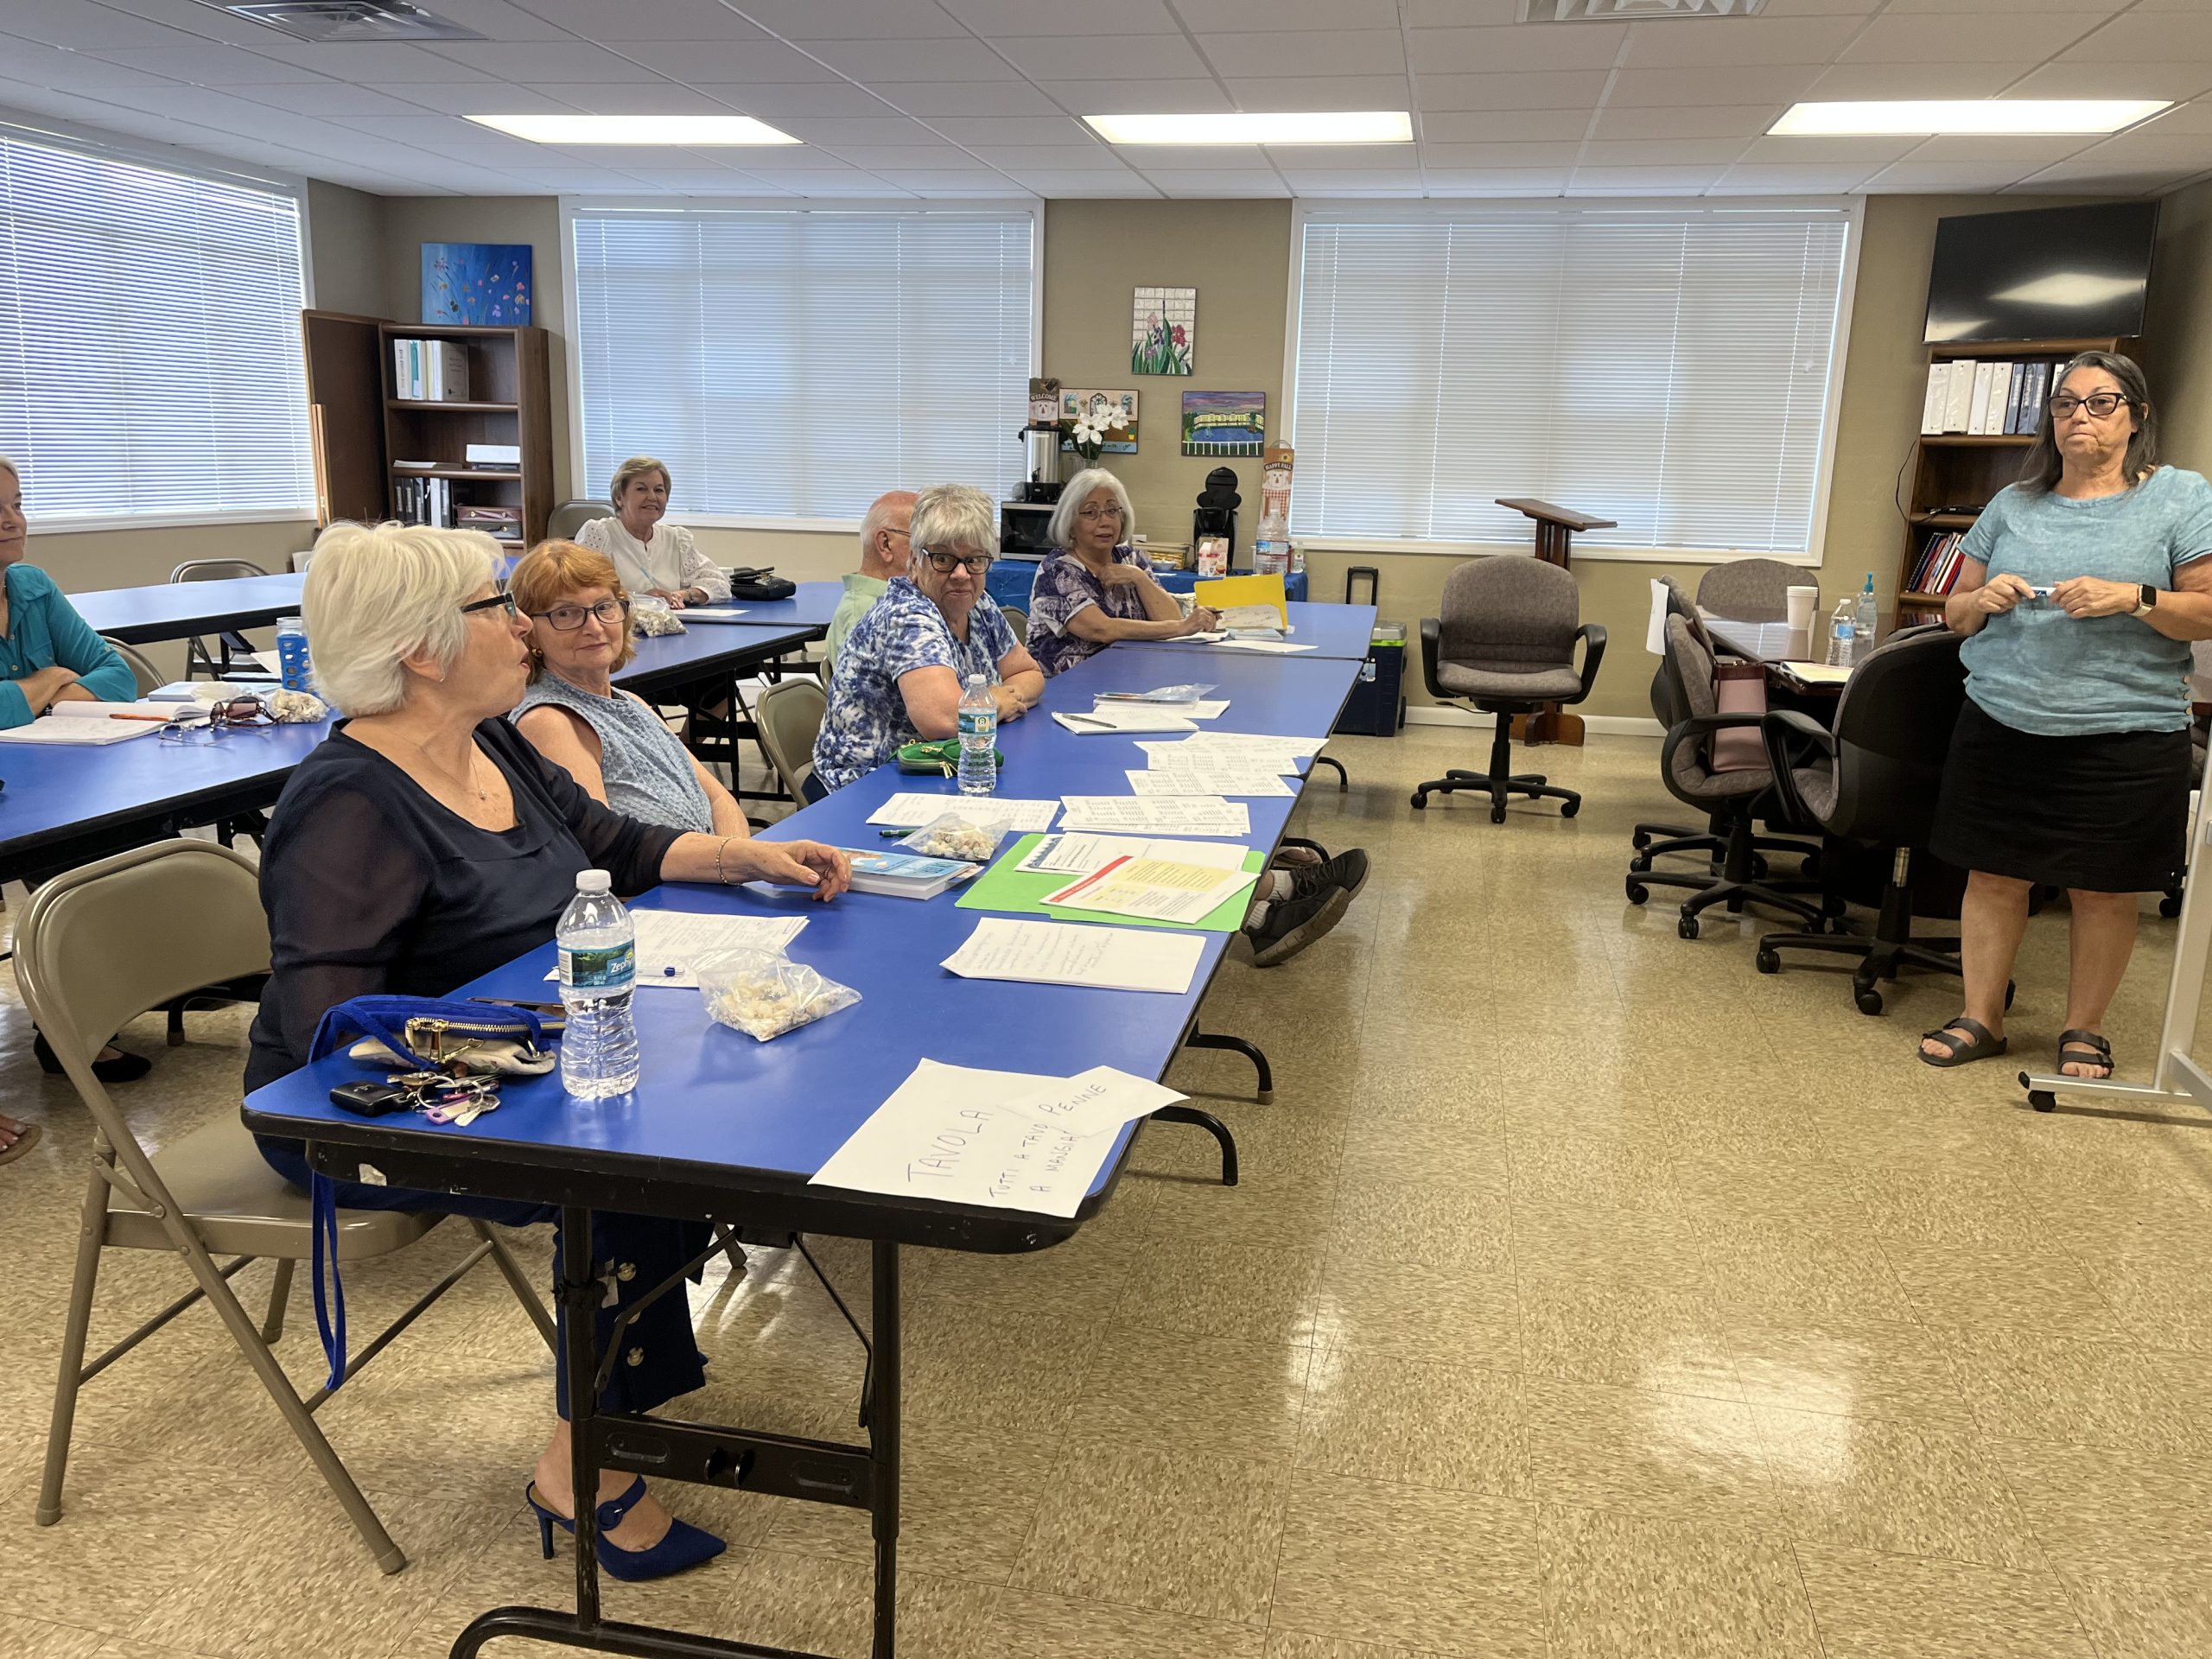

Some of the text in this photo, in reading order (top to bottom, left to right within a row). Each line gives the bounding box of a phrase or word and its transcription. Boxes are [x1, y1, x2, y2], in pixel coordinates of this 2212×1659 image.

[1039, 1084, 1107, 1116] PENNE
[907, 1109, 994, 1182] TAVOLA
[1045, 1130, 1079, 1172] MANGIA
[988, 1168, 1020, 1198] TUTTI
